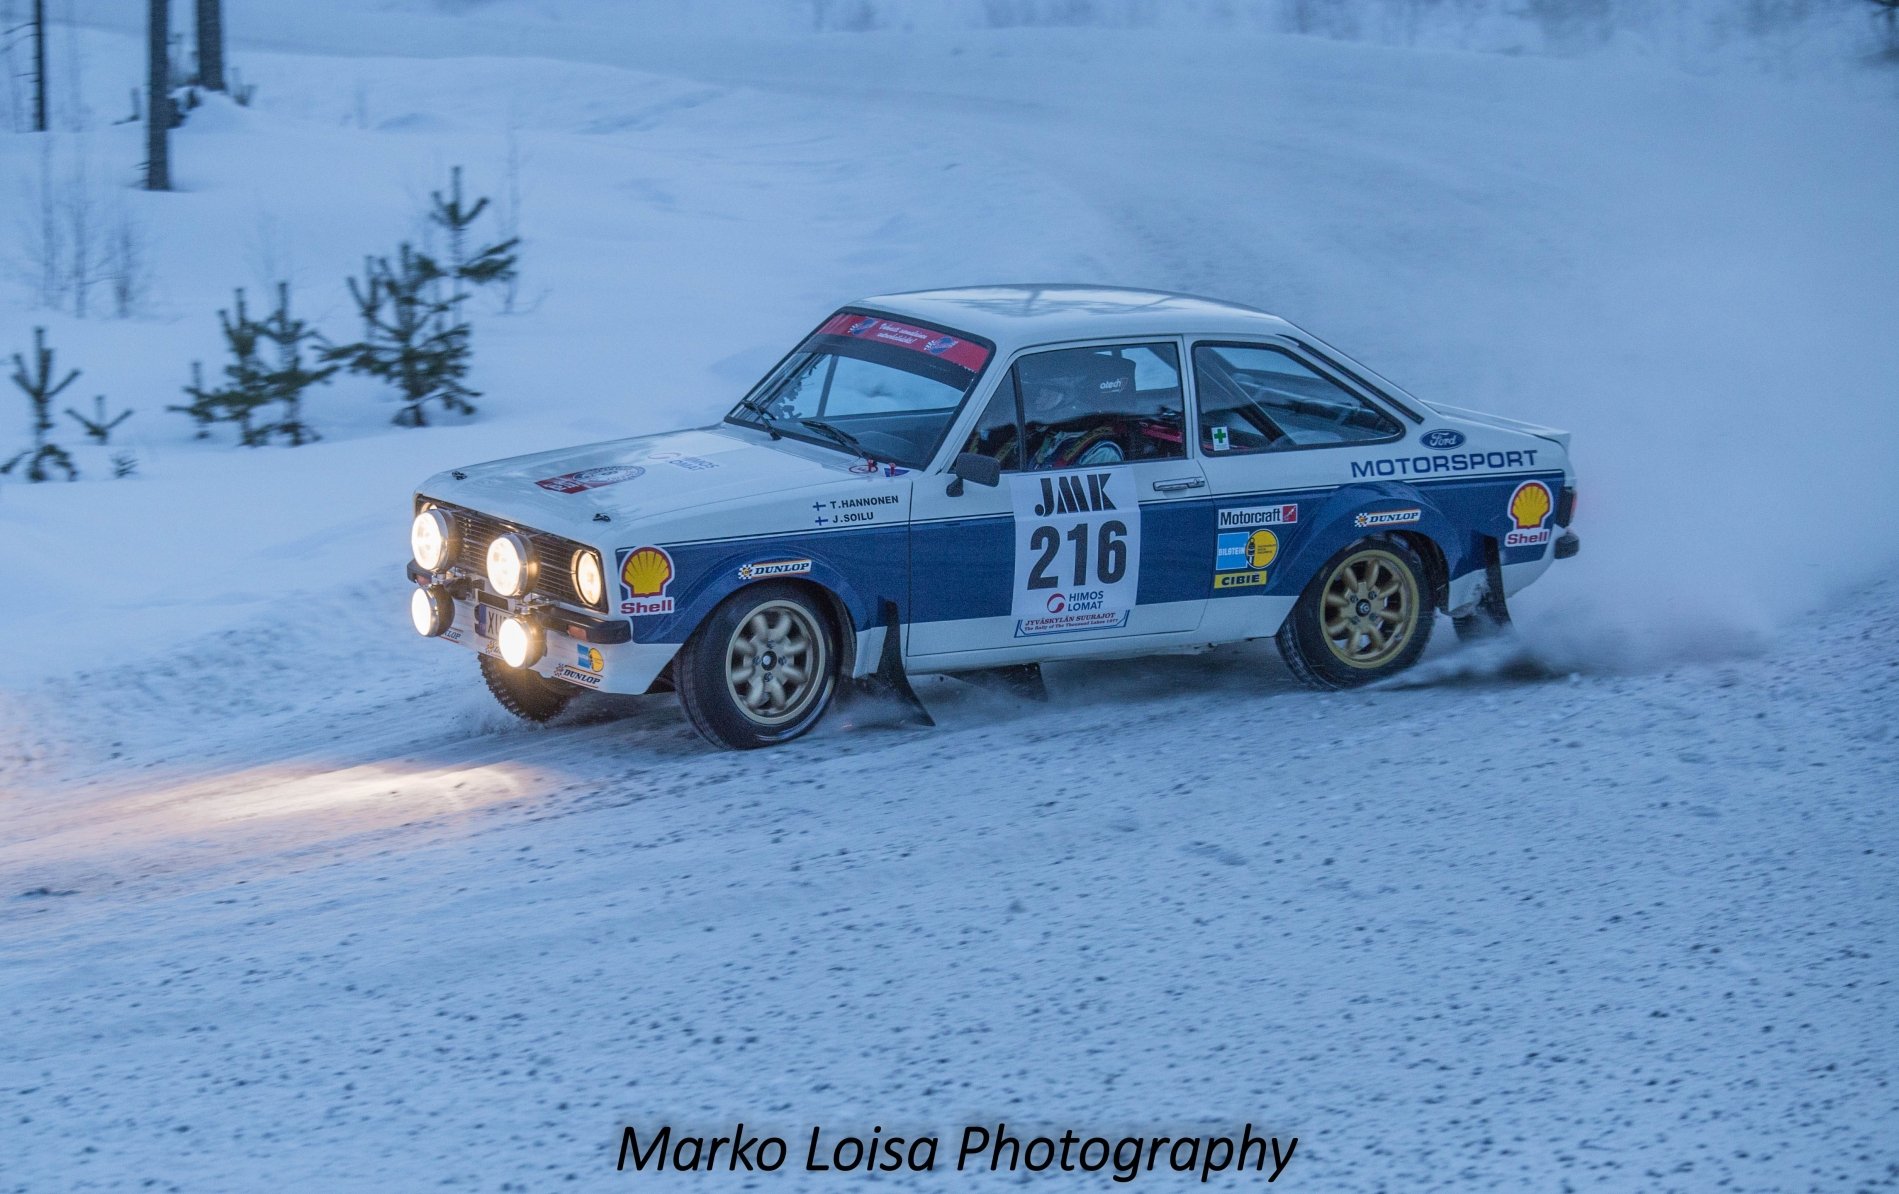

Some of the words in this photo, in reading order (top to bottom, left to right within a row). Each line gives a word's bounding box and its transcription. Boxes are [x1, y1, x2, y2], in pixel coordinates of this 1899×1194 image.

[1430, 432, 1457, 447] Ford
[1351, 450, 1538, 478] MOTORSPORT
[1034, 473, 1117, 517] JMK
[830, 495, 899, 510] T.HANNONEN
[832, 512, 874, 524] J.SOILU
[1220, 508, 1281, 526] Motorcraft
[1369, 512, 1419, 523] DUNLOP
[1507, 531, 1548, 545] Shell
[1027, 520, 1128, 590] 216
[1218, 546, 1245, 556] BILSTEIN
[755, 562, 810, 575] DUNLOP
[1069, 590, 1104, 602] HIMOS
[620, 599, 672, 614] Shell
[1067, 601, 1104, 612] LOMAT
[1025, 614, 1074, 626] JYVÄSKYLÄN
[1075, 612, 1116, 622] SUURAJOT
[563, 668, 601, 685] DUNLOP
